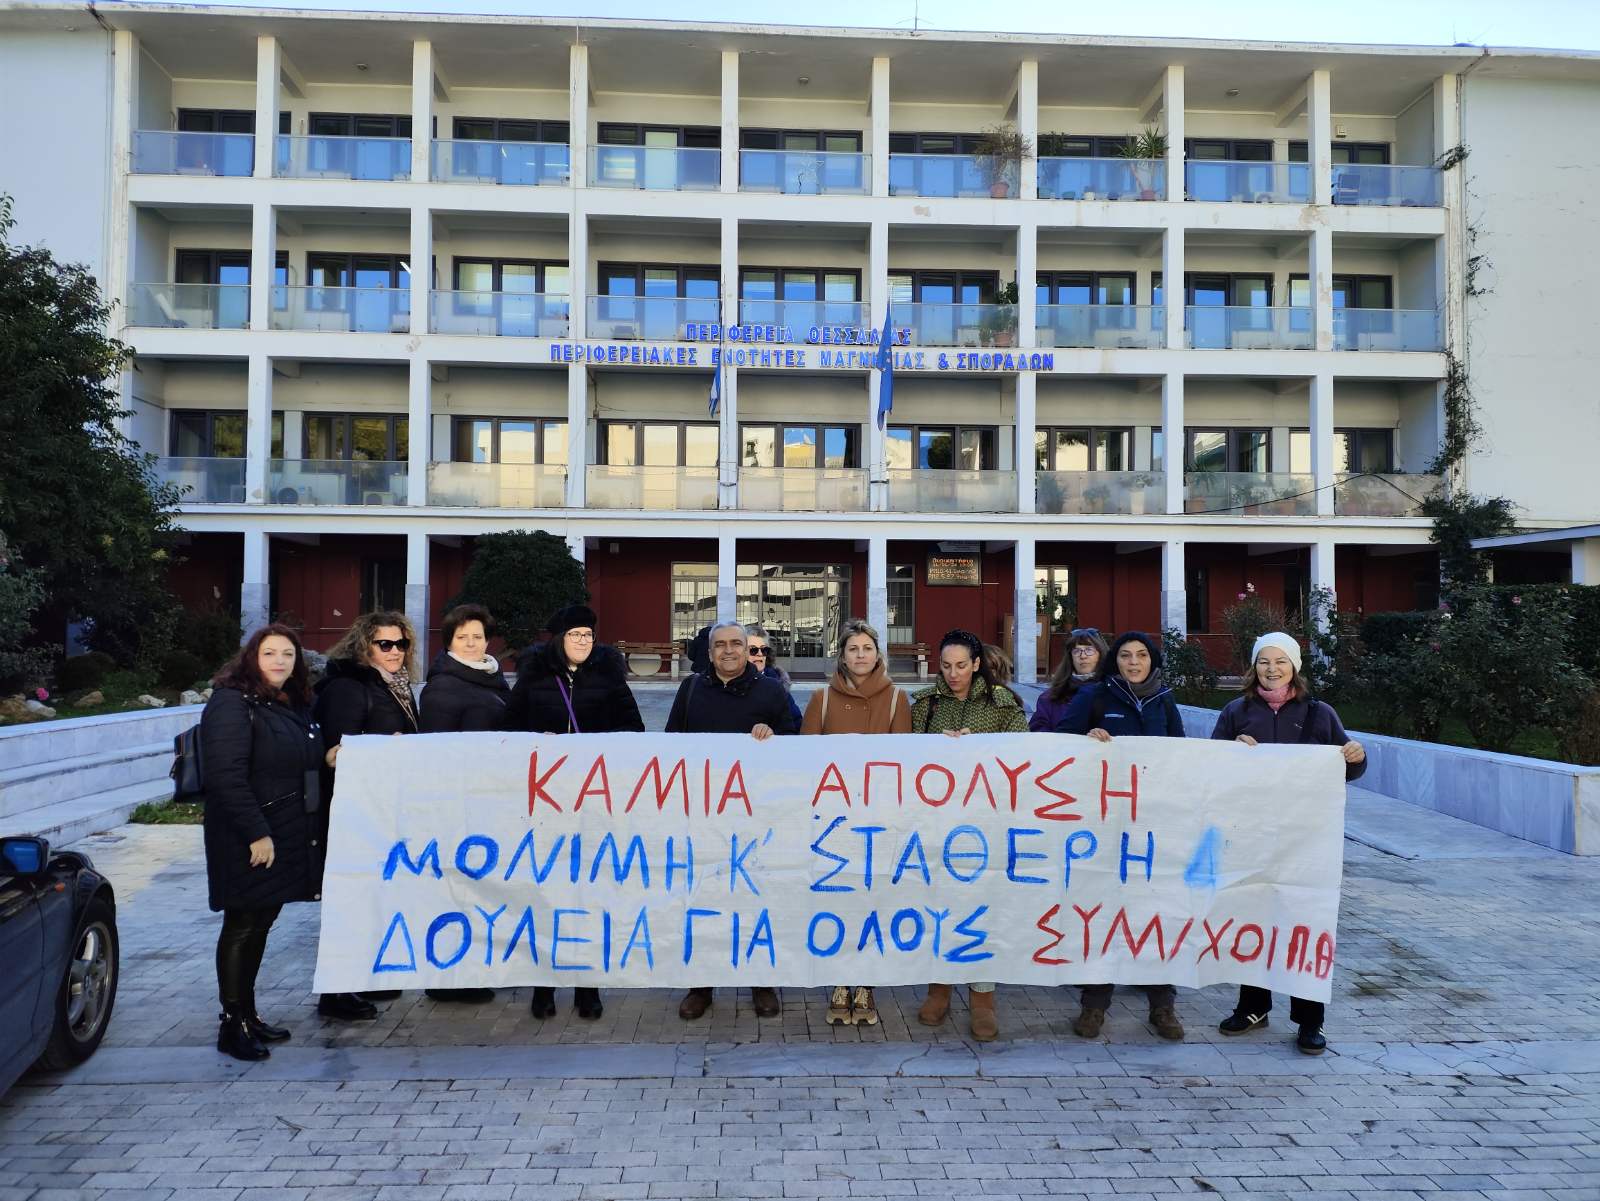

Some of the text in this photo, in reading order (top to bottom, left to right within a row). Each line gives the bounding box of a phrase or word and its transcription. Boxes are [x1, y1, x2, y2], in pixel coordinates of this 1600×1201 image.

[550, 343, 1054, 371] ΠΕΡΙΦΕΡΕΙΑΚΕΣ ΕΝΟΤΗΤΕΣ ΜΑΓΝΗΙΑΣ & ΣΠΟΡΑΔΩΝ
[808, 326, 912, 345] ΘΕΣΣΑΛΑΣ
[527, 750, 1139, 822] ΚΑΜΙΑ ΑΠΟΛΥΣΗ
[381, 828, 695, 893] ΜΟΝΙΜΗ
[809, 814, 1156, 893] ΣΤΑΘΕΡΗ
[370, 903, 994, 975] ΔΟΥΛΕΙΑ ΓΙΑ ΟΛΟΥΣ
